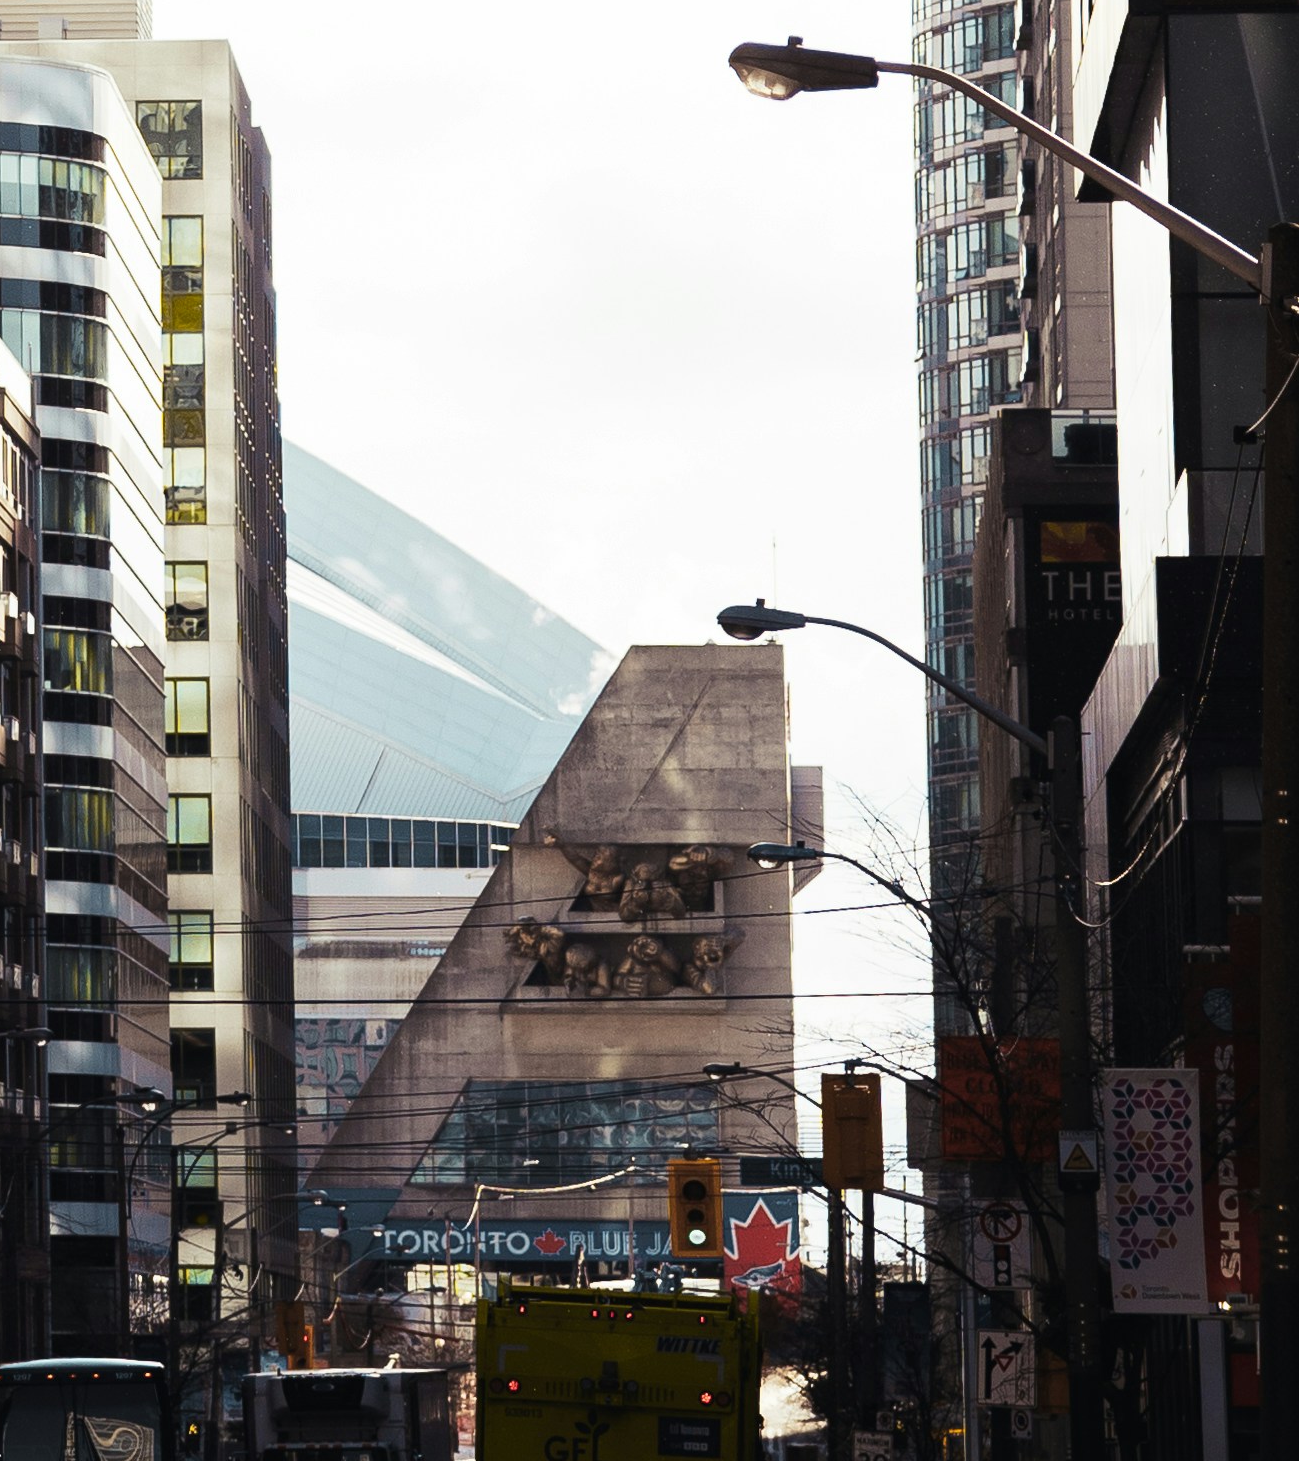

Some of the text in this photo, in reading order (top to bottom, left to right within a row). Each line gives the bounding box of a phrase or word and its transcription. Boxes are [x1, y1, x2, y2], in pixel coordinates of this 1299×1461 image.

[1042, 571, 1121, 601] THE
[1048, 609, 1114, 621] HOTEL
[770, 1160, 814, 1184] King
[384, 1229, 530, 1255] TORONTO
[569, 1230, 639, 1256] BLUE
[657, 1337, 721, 1355] WITTKE
